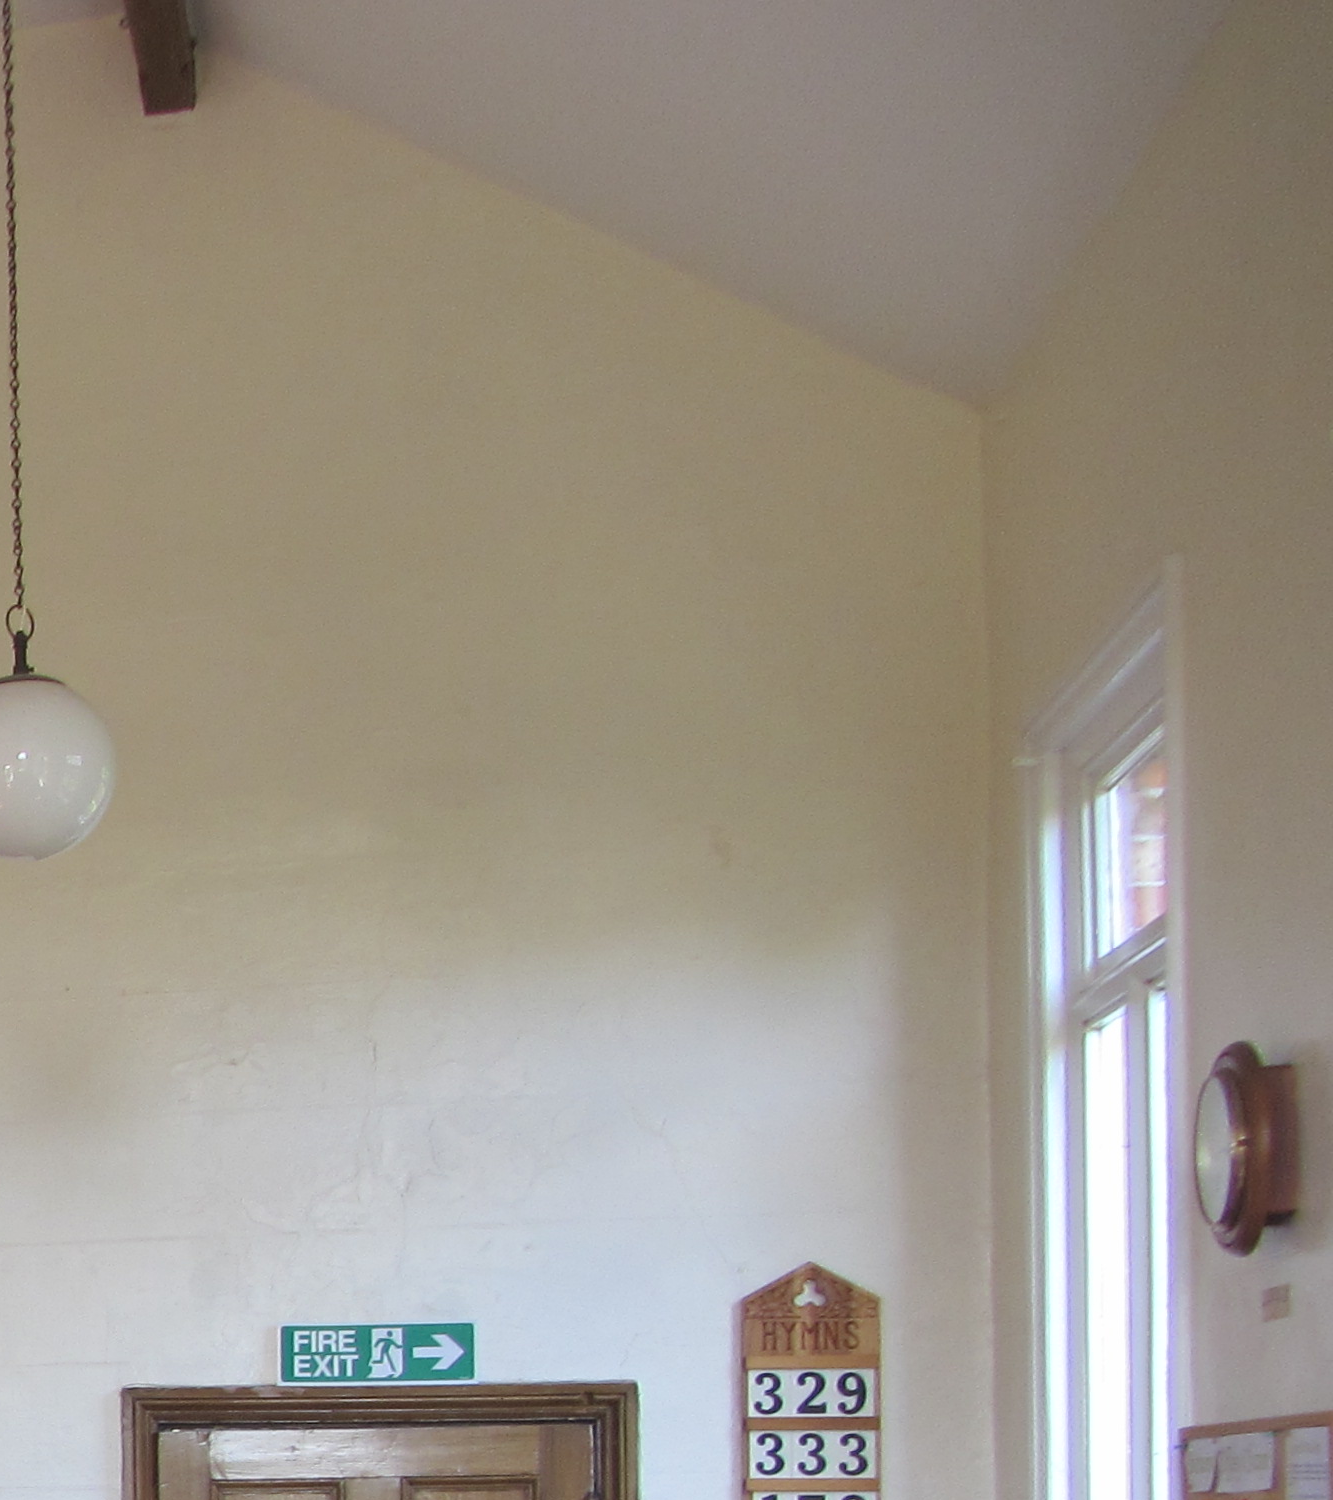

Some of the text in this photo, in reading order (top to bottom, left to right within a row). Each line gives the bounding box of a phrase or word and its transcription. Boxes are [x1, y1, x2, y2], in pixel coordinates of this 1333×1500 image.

[293, 1330, 356, 1353] FIRE
[762, 1321, 859, 1350] HYMNS
[293, 1354, 359, 1378] EXIT
[754, 1372, 867, 1415] 329
[755, 1433, 868, 1476] 333
